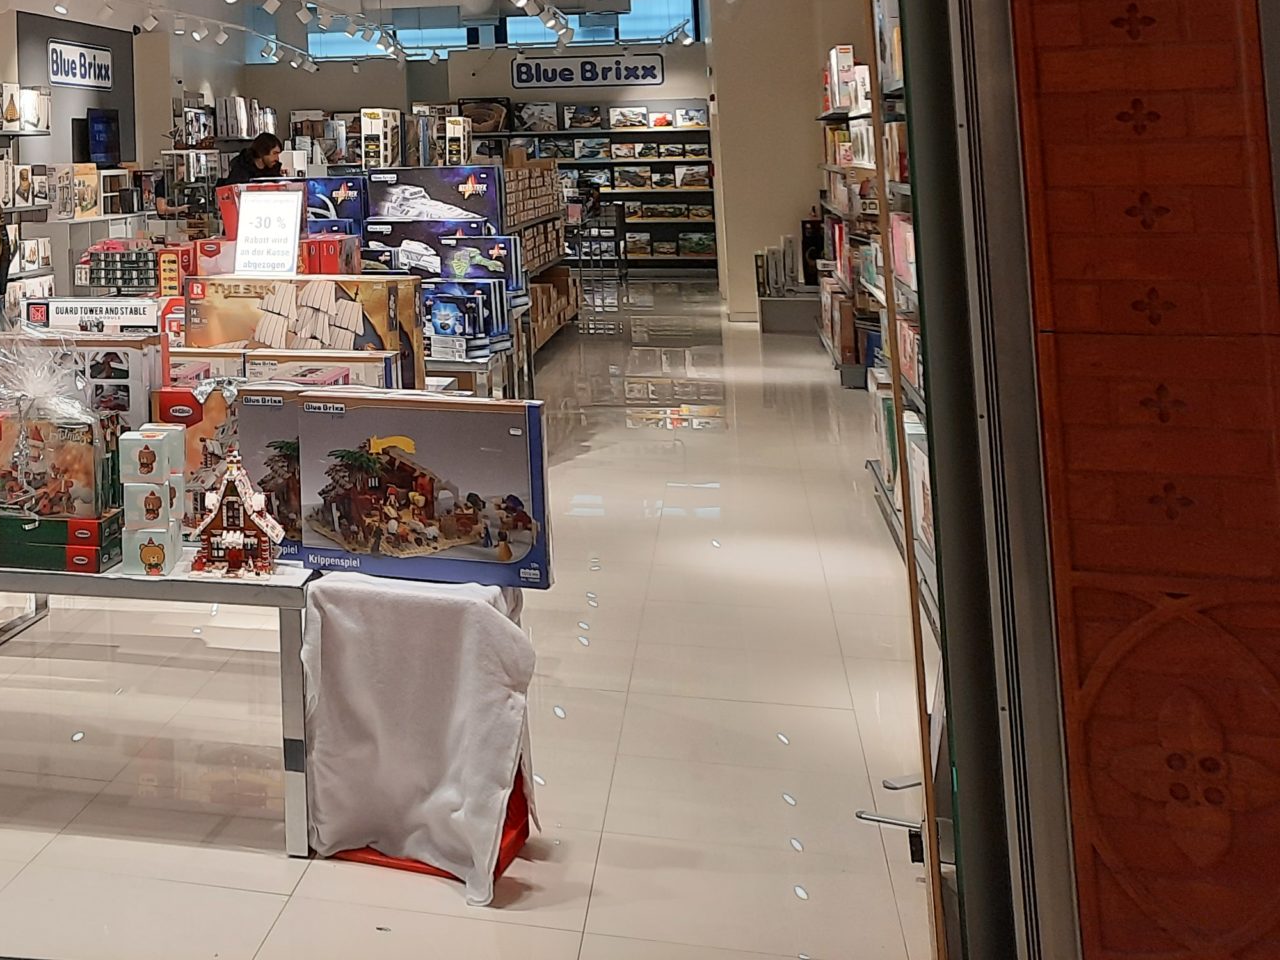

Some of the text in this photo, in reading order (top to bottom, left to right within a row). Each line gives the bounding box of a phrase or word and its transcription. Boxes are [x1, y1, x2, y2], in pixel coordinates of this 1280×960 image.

[51, 47, 111, 82] Blue Brixx
[516, 60, 658, 83] Blue Brixx
[249, 216, 271, 229] -30
[243, 260, 286, 269] abgezogen
[55, 306, 147, 315] GUARD TOWER AND STABLE
[308, 554, 362, 568] Krippenspiel
